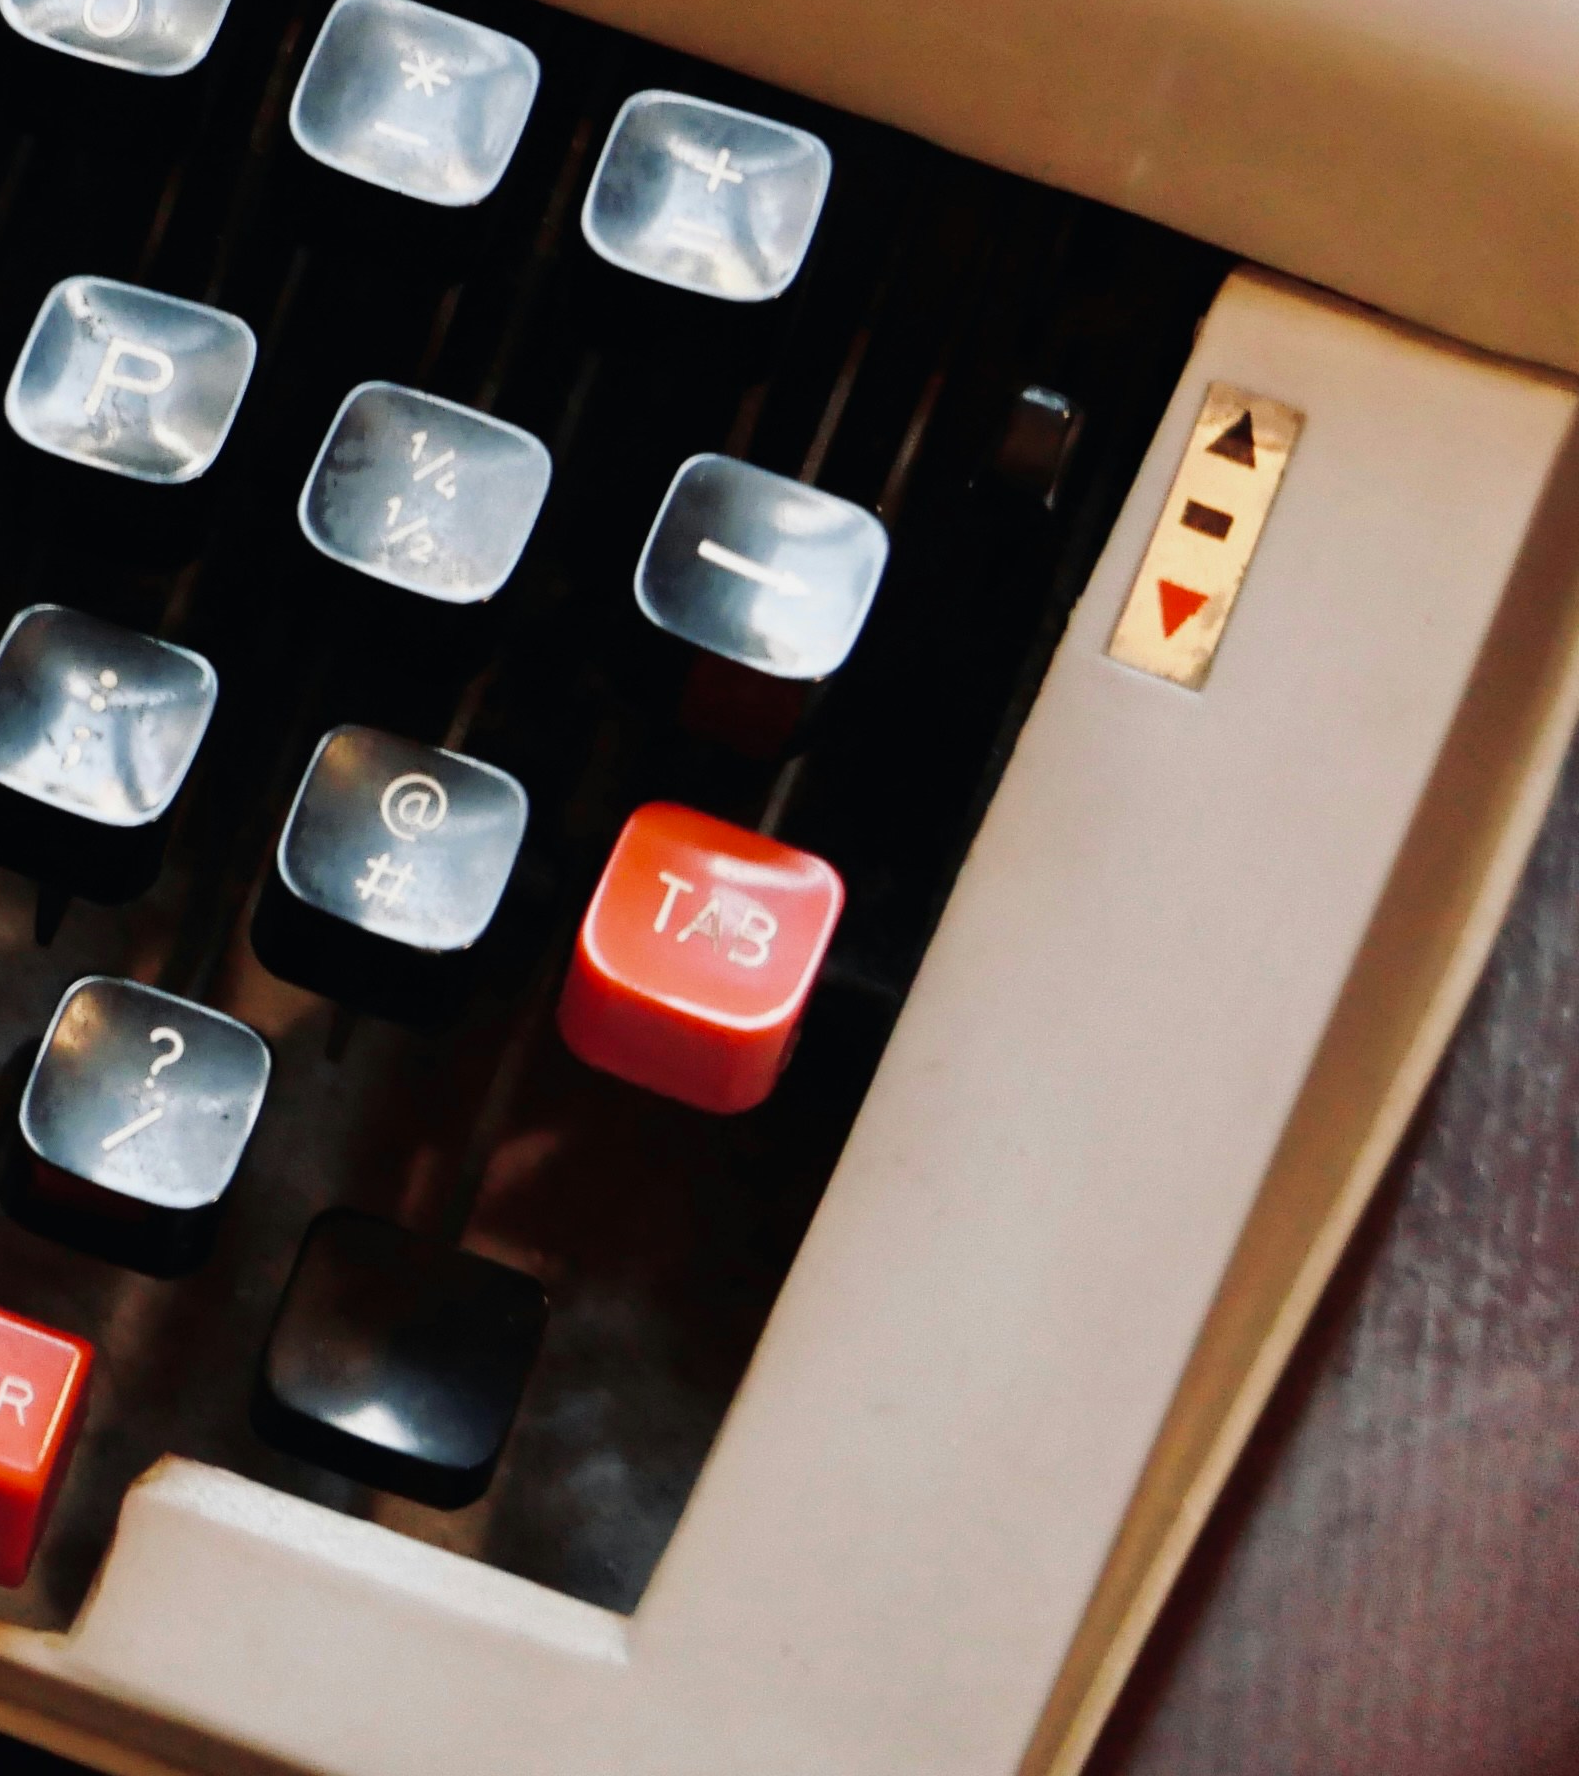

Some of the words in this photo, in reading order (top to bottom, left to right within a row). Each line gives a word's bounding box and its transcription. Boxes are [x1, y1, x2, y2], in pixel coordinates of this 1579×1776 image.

[695, 147, 743, 193] +
[666, 218, 721, 255] =
[83, 336, 174, 415] P
[381, 773, 447, 842] @
[354, 853, 415, 907] #
[659, 872, 778, 968] TAB
[144, 1026, 185, 1088] ?
[101, 1107, 163, 1152] /
